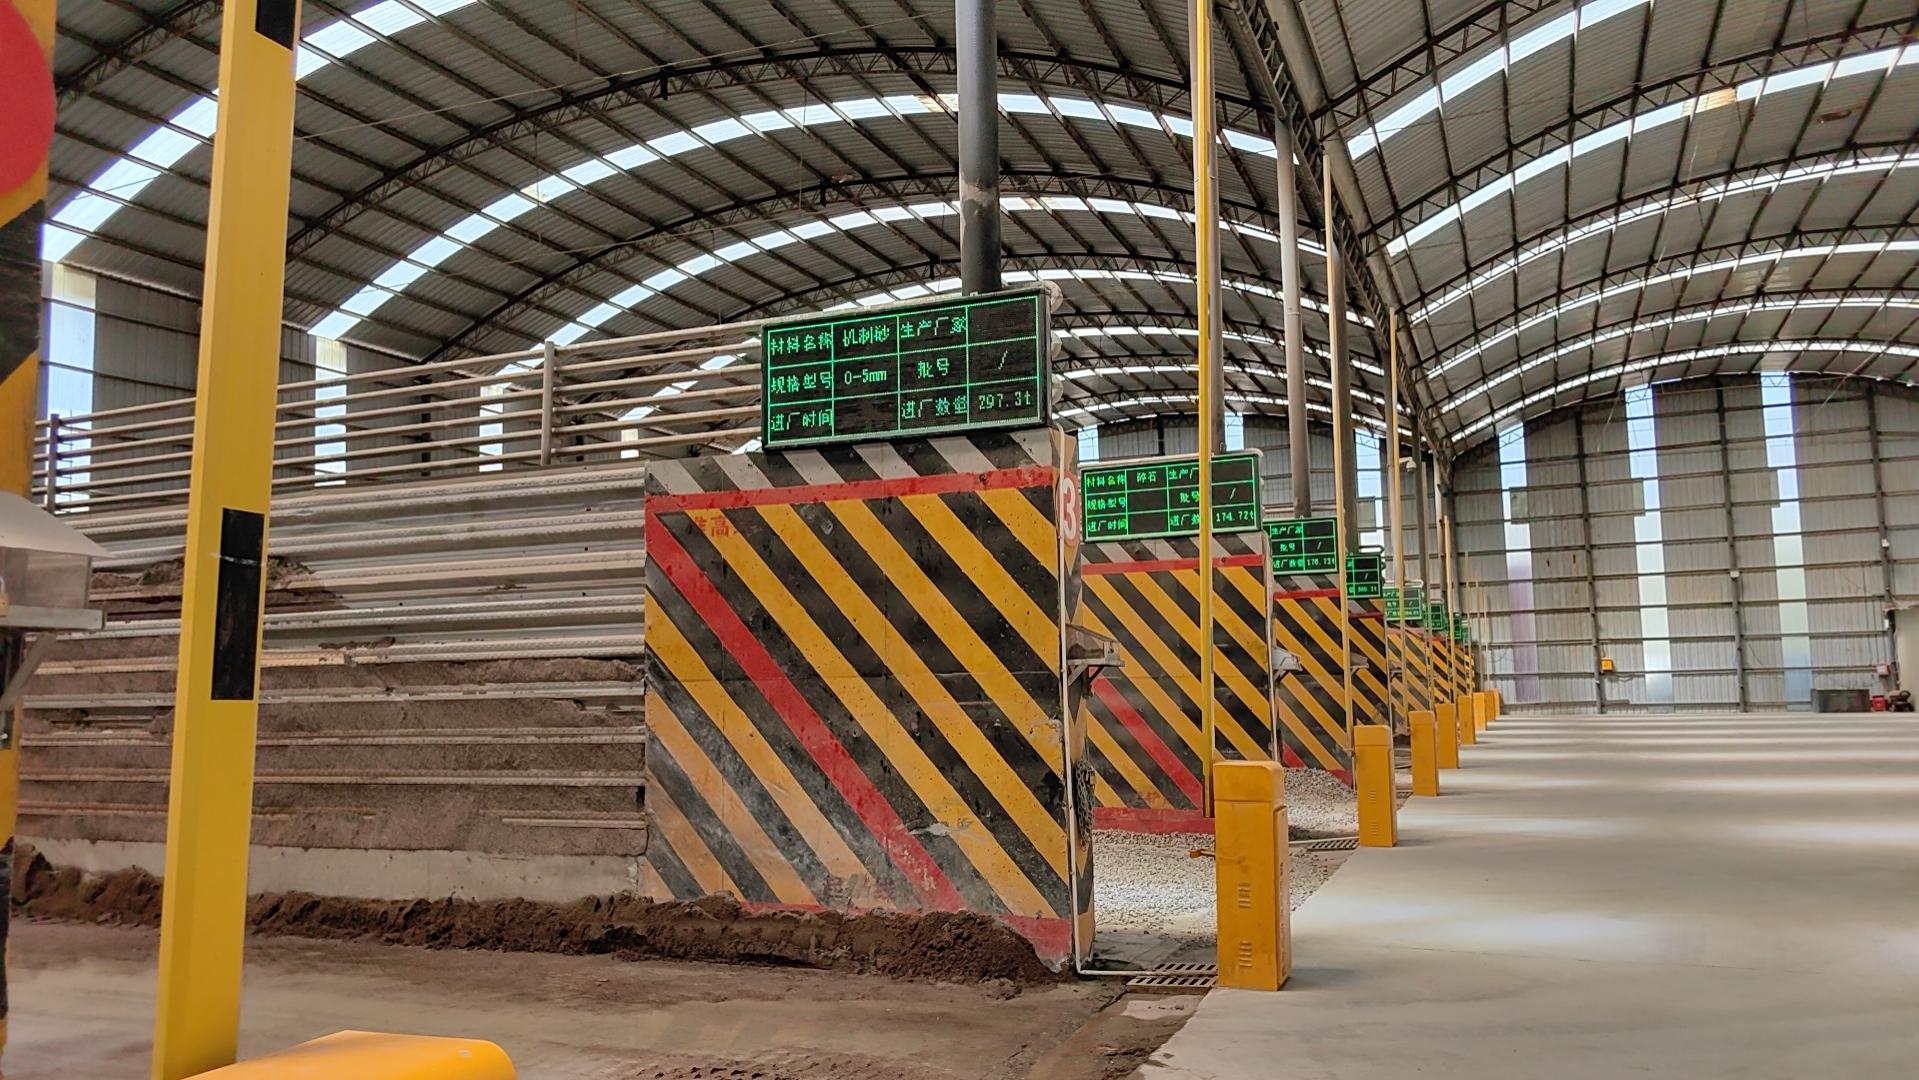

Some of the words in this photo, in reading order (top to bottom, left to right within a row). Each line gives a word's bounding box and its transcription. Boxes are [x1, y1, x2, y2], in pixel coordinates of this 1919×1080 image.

[770, 331, 833, 356] 材料名称
[843, 326, 891, 347] 机制砂
[900, 315, 967, 339] 生产厂家
[770, 371, 833, 394] 规格型号
[844, 369, 887, 385] 0-5mm
[917, 357, 950, 379] 批号
[770, 408, 833, 432] 进厂时间
[901, 395, 967, 419] 进厂数量
[1086, 472, 1125, 487] 材料名称
[1136, 470, 1157, 483] 碎石
[1168, 467, 1200, 480] 生产厂
[1086, 496, 1126, 511] 规格型号
[1087, 518, 1127, 533] 进厂时间
[1169, 513, 1200, 527] 进厂数
